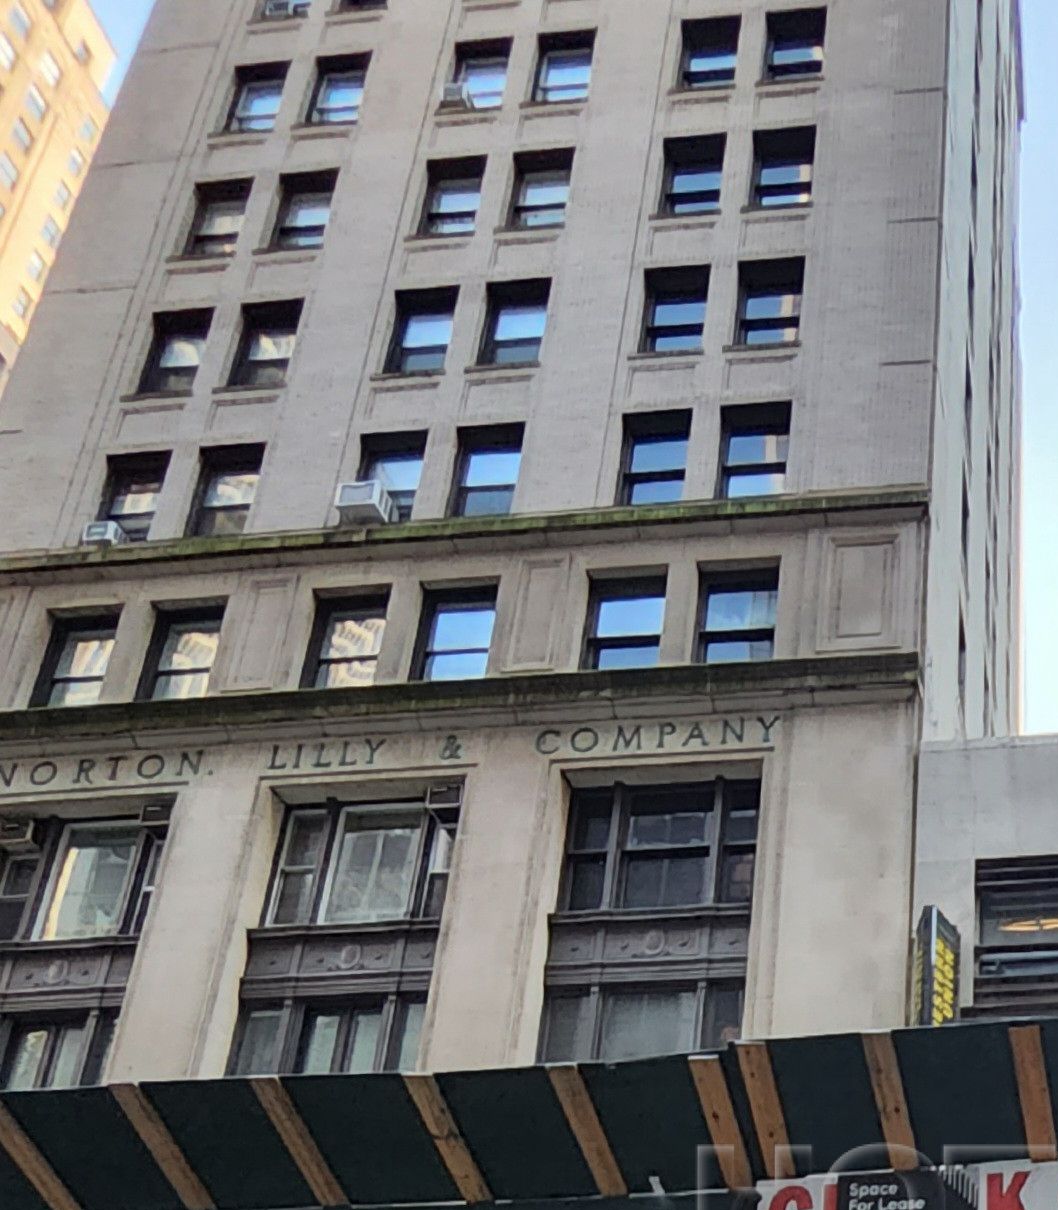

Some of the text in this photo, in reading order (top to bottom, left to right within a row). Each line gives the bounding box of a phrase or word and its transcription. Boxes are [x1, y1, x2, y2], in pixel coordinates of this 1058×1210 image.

[267, 737, 388, 770] LILLY
[439, 733, 463, 762] &
[536, 716, 783, 755] COMPANY
[849, 1183, 898, 1198] Space
